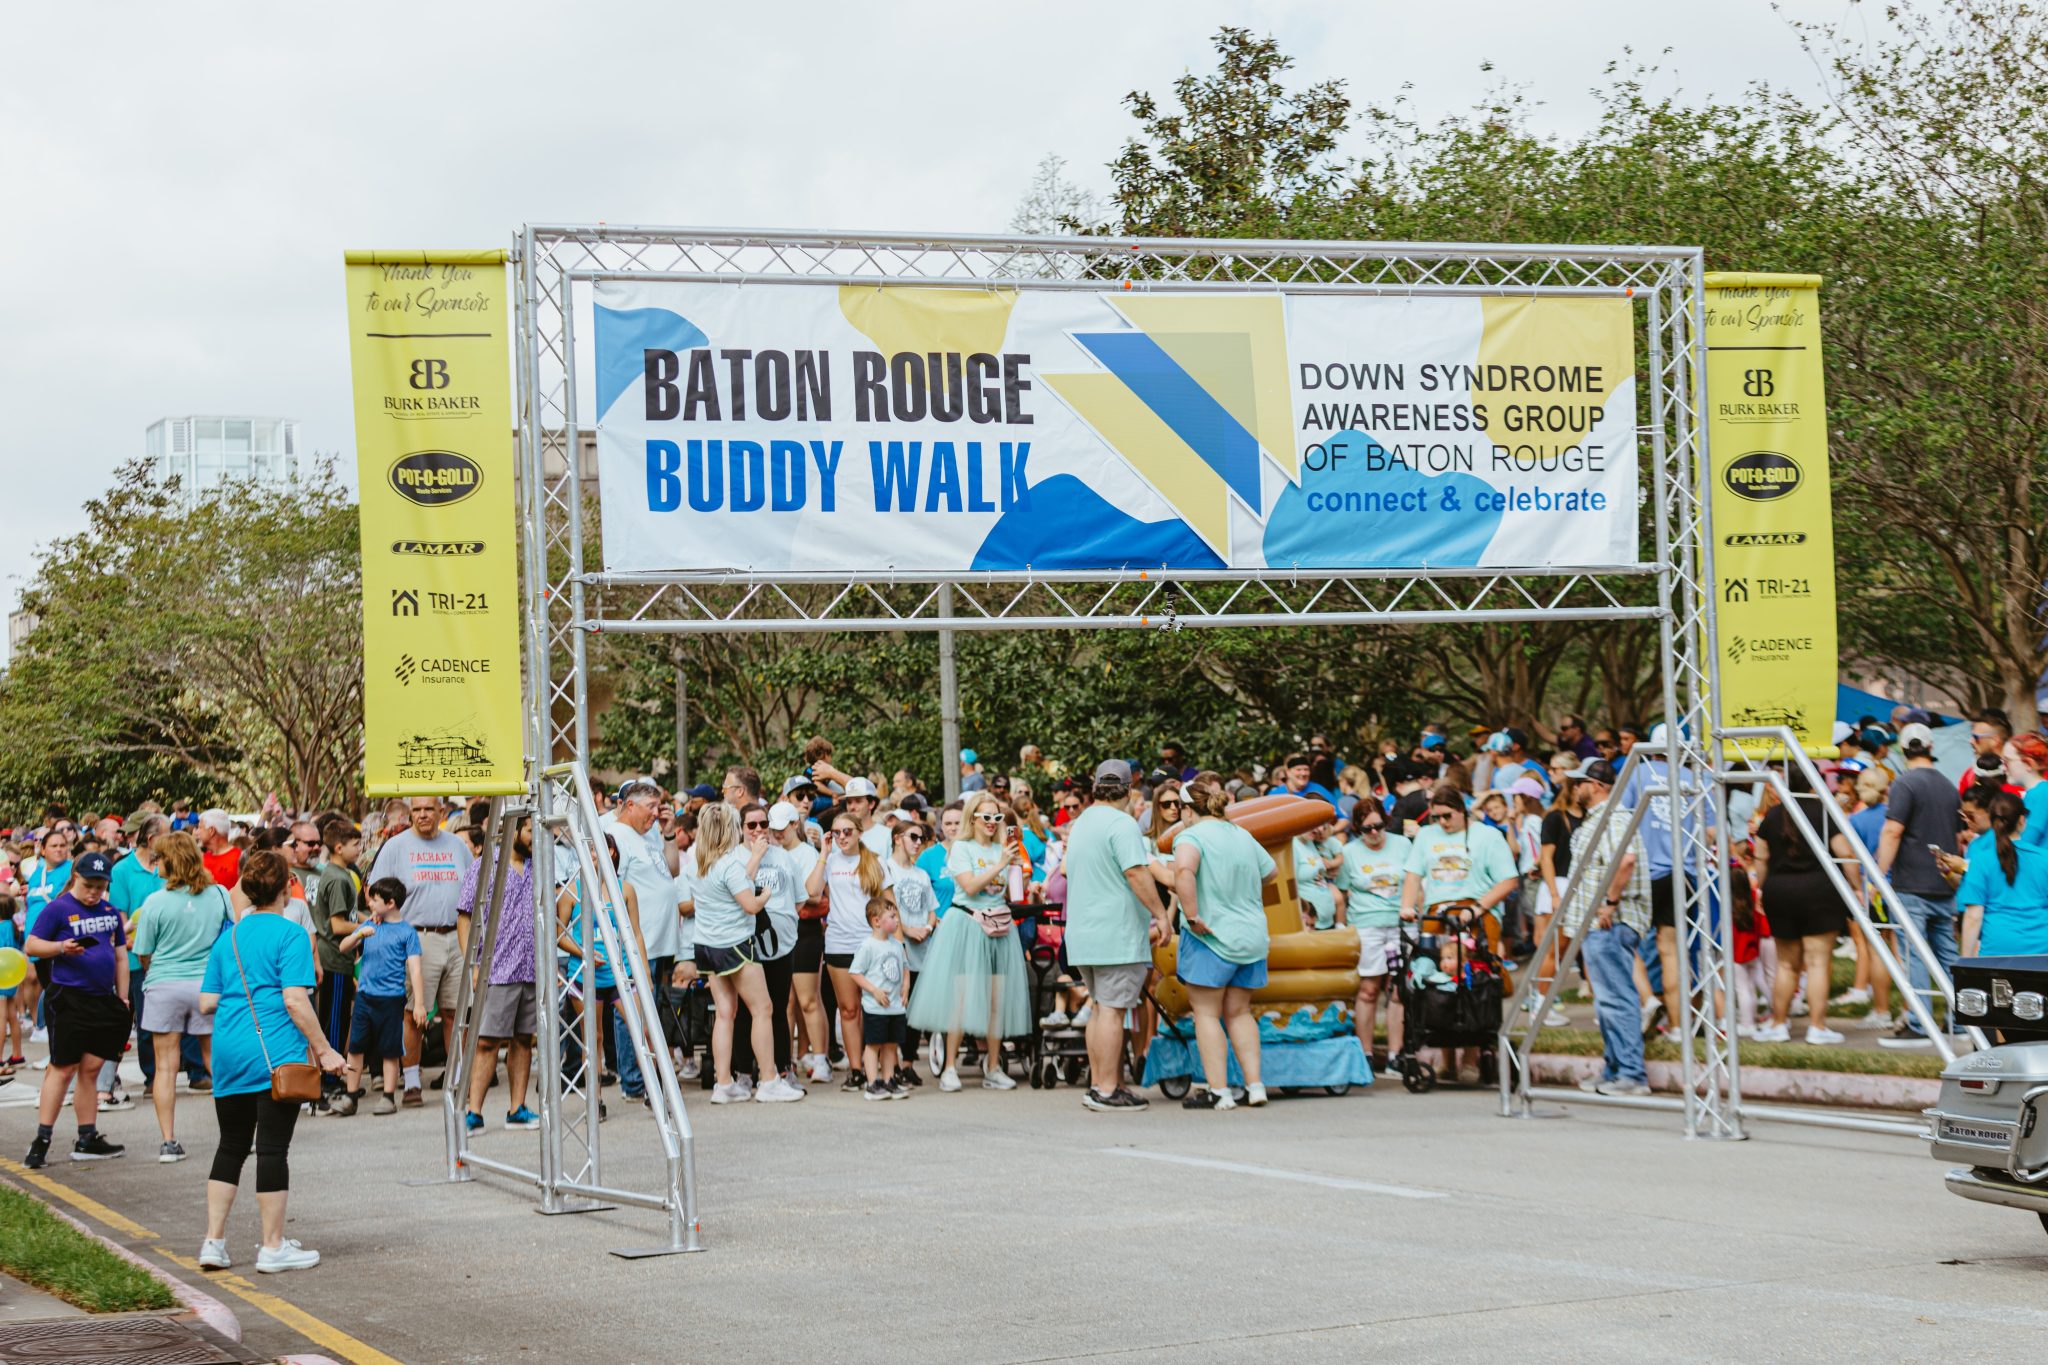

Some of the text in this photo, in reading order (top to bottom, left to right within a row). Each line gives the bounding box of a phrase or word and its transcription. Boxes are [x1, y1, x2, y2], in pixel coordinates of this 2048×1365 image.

[441, 263, 473, 289] You
[364, 287, 490, 319] to our Sponsors
[1721, 309, 1742, 327] our
[1746, 304, 1804, 332] Sponsors
[644, 349, 1034, 425] BATON ROUGE
[1300, 363, 1603, 393] DOWN SYNDROME
[384, 396, 480, 410] BURK BAKER
[1719, 403, 1800, 416] BURK BAKER
[1302, 403, 1604, 432] AWARENESS GROUP
[1304, 444, 1605, 472] OF BATON ROUGE
[397, 467, 474, 486] POT-O-GOLD
[645, 439, 1033, 513] BUDDY WALK
[1730, 466, 1797, 484] POT-O-GOLD
[1307, 485, 1606, 512] connect & celebrate
[399, 542, 476, 555] LAMAR
[1731, 534, 1801, 545] LAMAR
[1757, 579, 1811, 593] TRI-21
[428, 592, 488, 610] TRI-21
[1750, 638, 1812, 651] CADENCE
[421, 659, 490, 673] CADENCE
[1751, 653, 1790, 662] Insurance
[422, 675, 465, 684] Insurance
[399, 767, 492, 780] Rusty Pelican
[69, 915, 119, 936] TIGERS
[1949, 1126, 2008, 1140] BATON ROUGE
